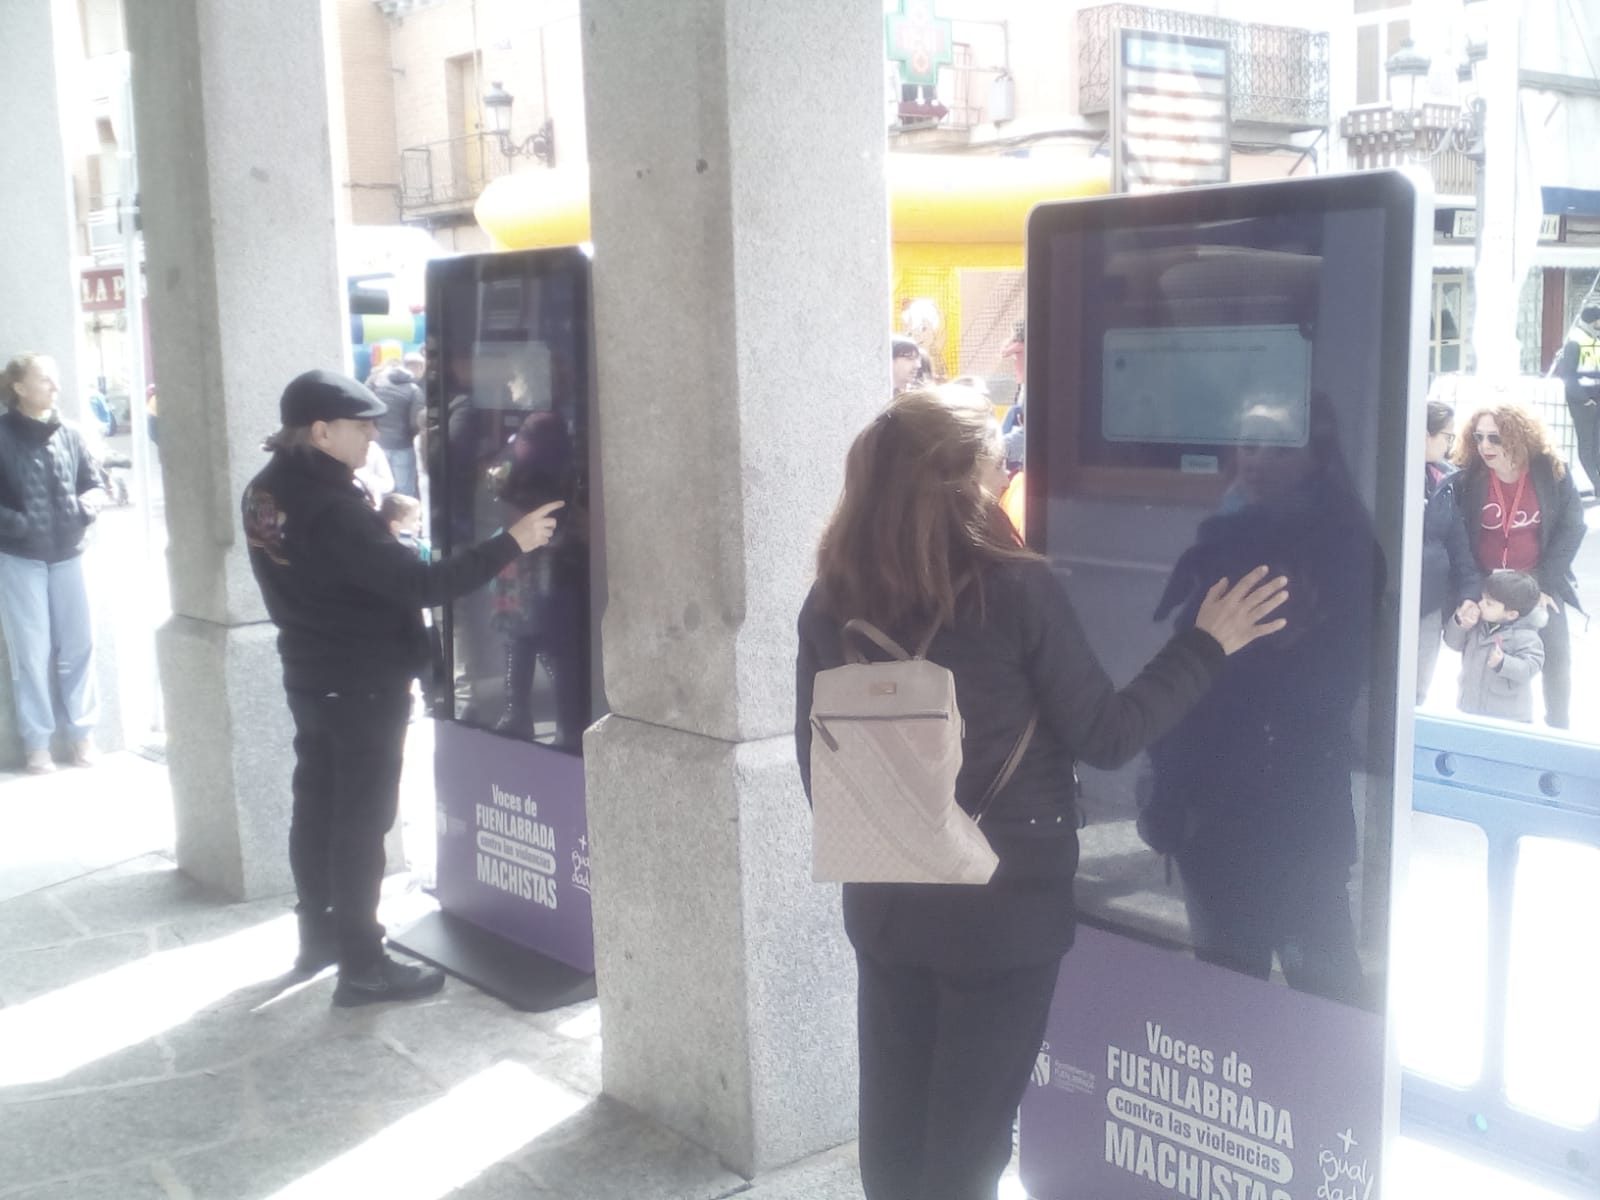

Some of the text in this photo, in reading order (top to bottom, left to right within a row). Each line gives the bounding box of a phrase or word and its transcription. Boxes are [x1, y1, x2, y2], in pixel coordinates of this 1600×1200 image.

[475, 803, 556, 852] FUENLABRADA
[491, 784, 538, 817] Voces de
[476, 853, 558, 910] MACHISTAS
[1146, 1021, 1252, 1088] Voces de
[1107, 1044, 1294, 1149] FUENLABRADA
[1115, 1095, 1281, 1175] contra las violencias
